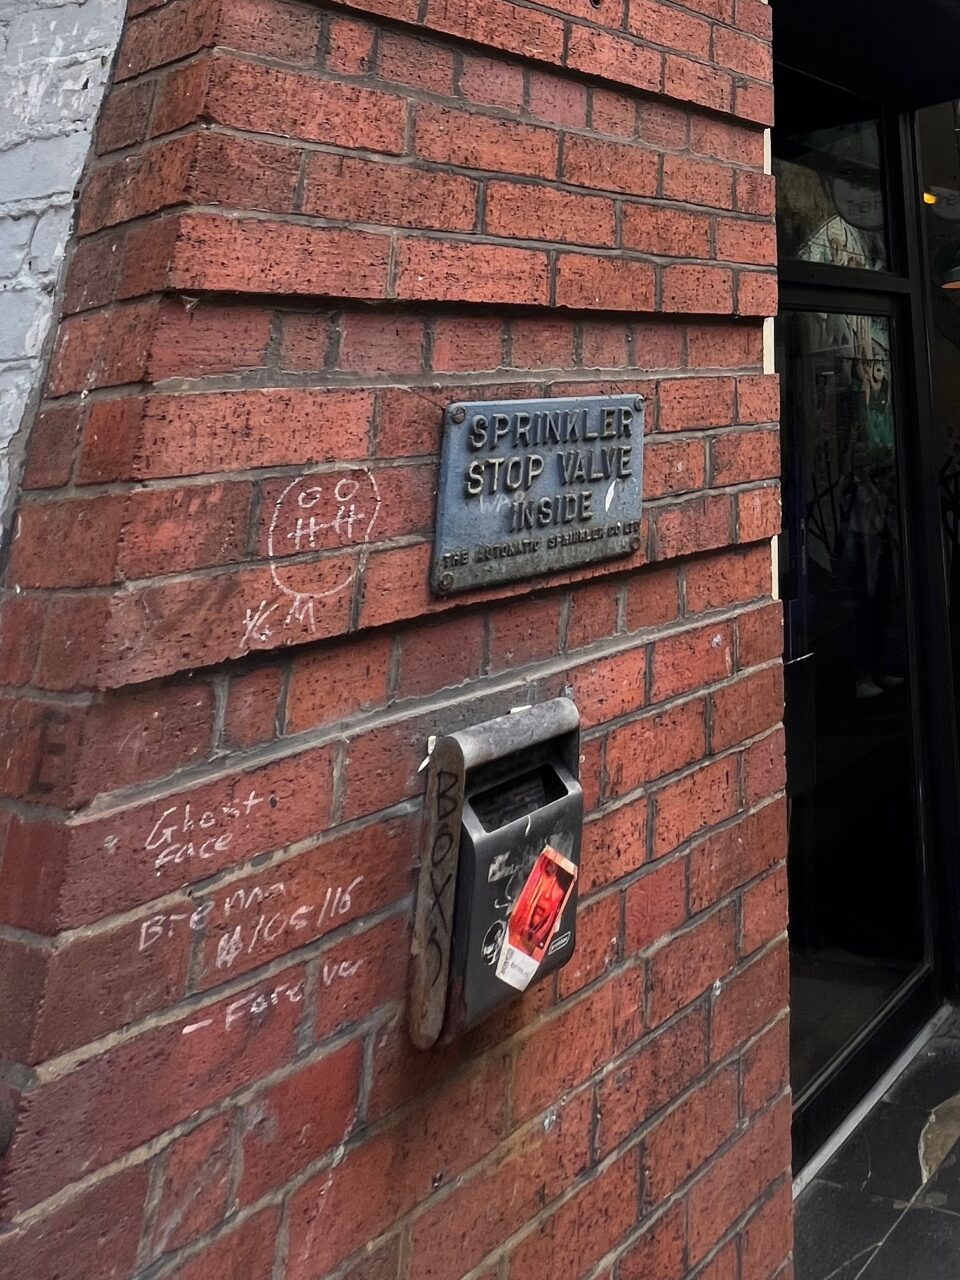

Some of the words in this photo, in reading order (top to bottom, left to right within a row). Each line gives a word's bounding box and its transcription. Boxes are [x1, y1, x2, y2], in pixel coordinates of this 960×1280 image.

[468, 406, 634, 450] SPRINKLER
[465, 454, 544, 497] STOP
[558, 446, 632, 486] VALVE
[509, 490, 593, 532] INSIDE
[443, 550, 468, 568] THE
[145, 790, 263, 849] Ghost
